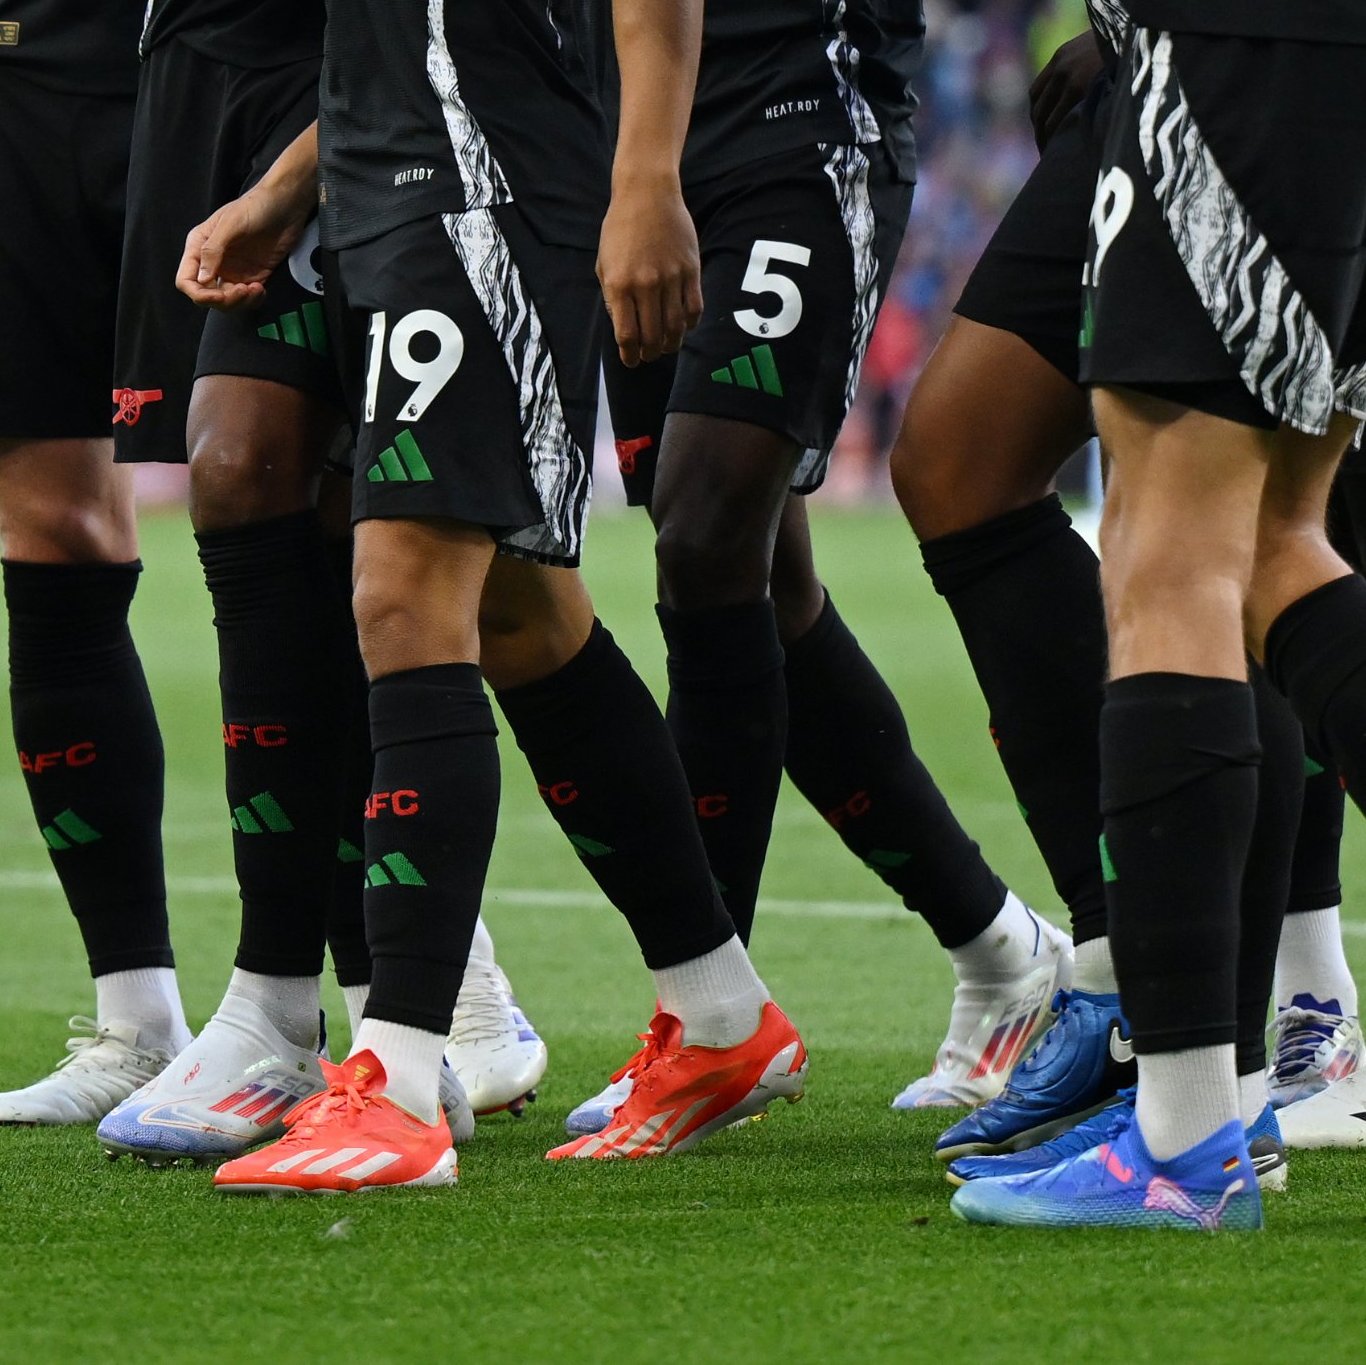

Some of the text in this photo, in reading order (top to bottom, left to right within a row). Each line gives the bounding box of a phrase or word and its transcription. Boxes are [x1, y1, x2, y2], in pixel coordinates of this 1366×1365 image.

[765, 99, 820, 120] HEAT.RDY
[733, 239, 811, 339] 5
[365, 309, 464, 423] 19
